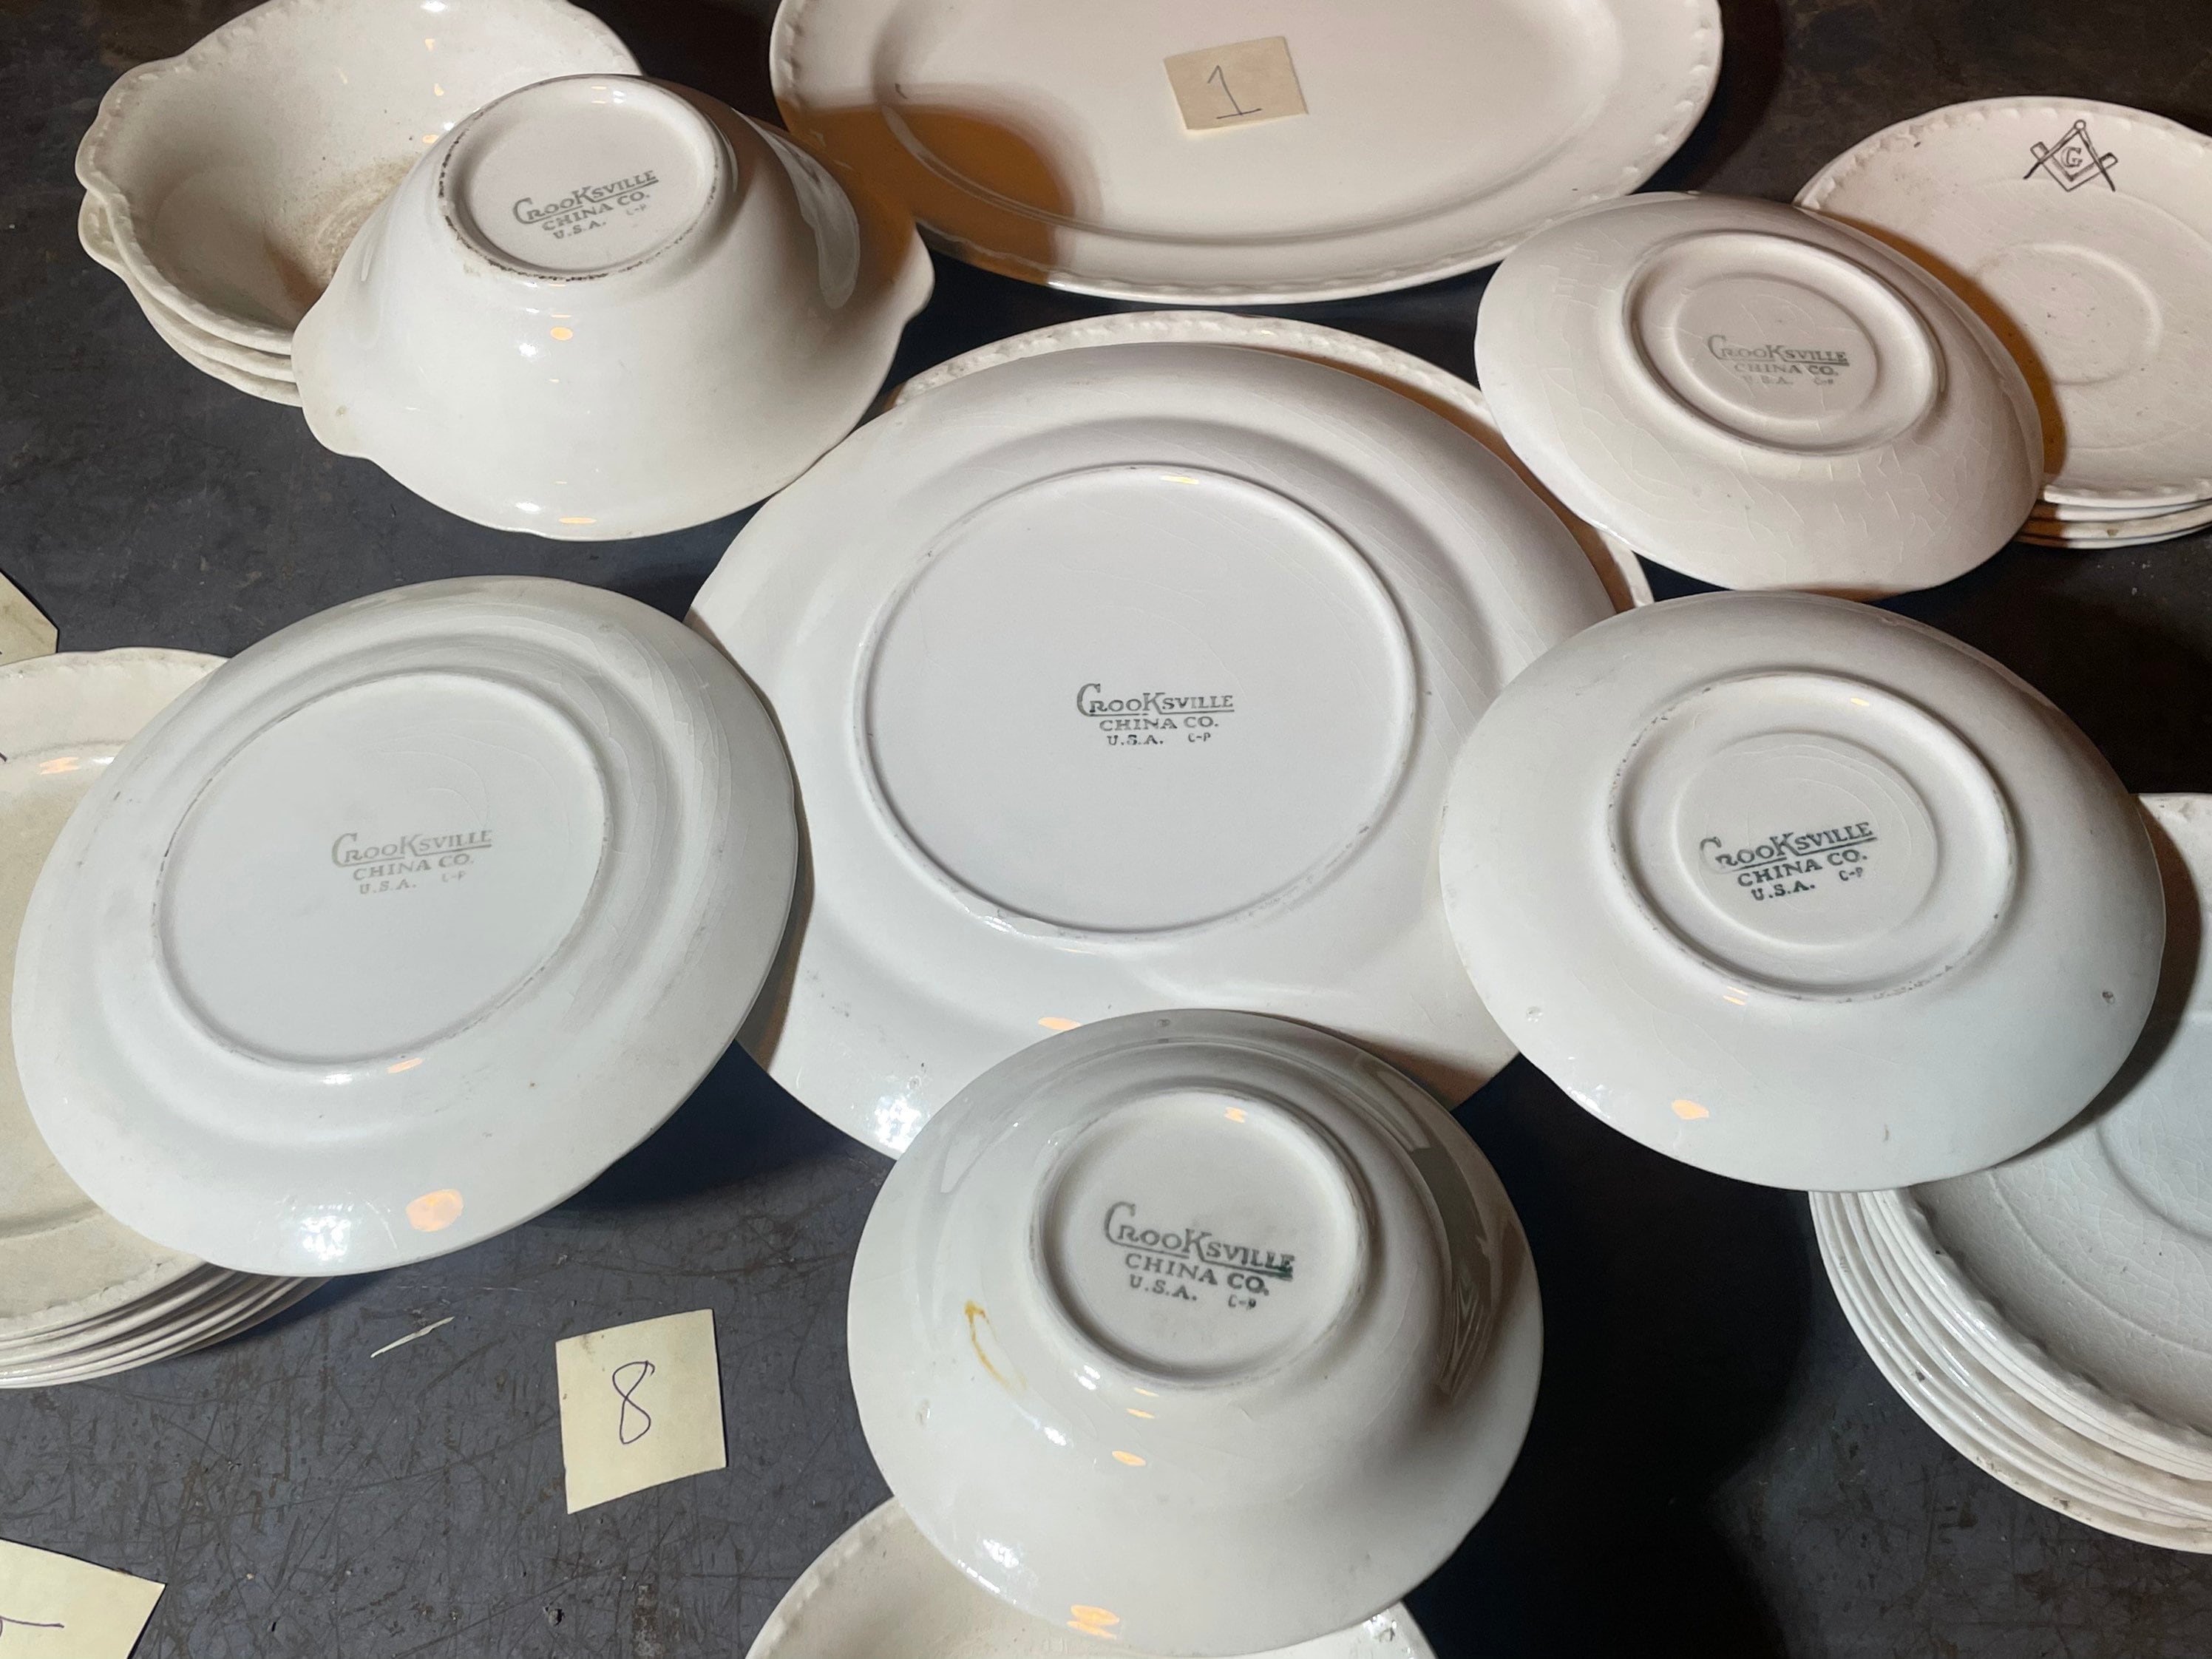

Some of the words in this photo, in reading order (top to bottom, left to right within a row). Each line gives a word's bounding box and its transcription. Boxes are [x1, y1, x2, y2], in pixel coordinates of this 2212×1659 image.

[1207, 65, 1262, 119] 1
[2060, 146, 2083, 168] G
[542, 203, 613, 230] CHINA
[617, 191, 650, 206] CO.
[553, 220, 606, 239] U.S.A.
[1734, 363, 1802, 374] CHINA
[1808, 364, 1839, 376] CO.
[1099, 718, 1178, 731] CHINA
[1184, 716, 1218, 728] CO.
[1107, 734, 1164, 745] U.S.A.
[1188, 732, 1211, 742] C-P
[353, 859, 431, 881] CHINA
[438, 853, 475, 868] CO.
[1737, 859, 1823, 886] CHINA
[1827, 849, 1867, 866] CO.
[359, 878, 417, 895] U.S.A.
[1751, 881, 1815, 900] U.S.A.
[1124, 1253, 1218, 1286] CHINA
[1227, 1272, 1269, 1296] CO.
[1130, 1275, 1197, 1300] U.S.A.
[612, 1360, 655, 1445] 8
